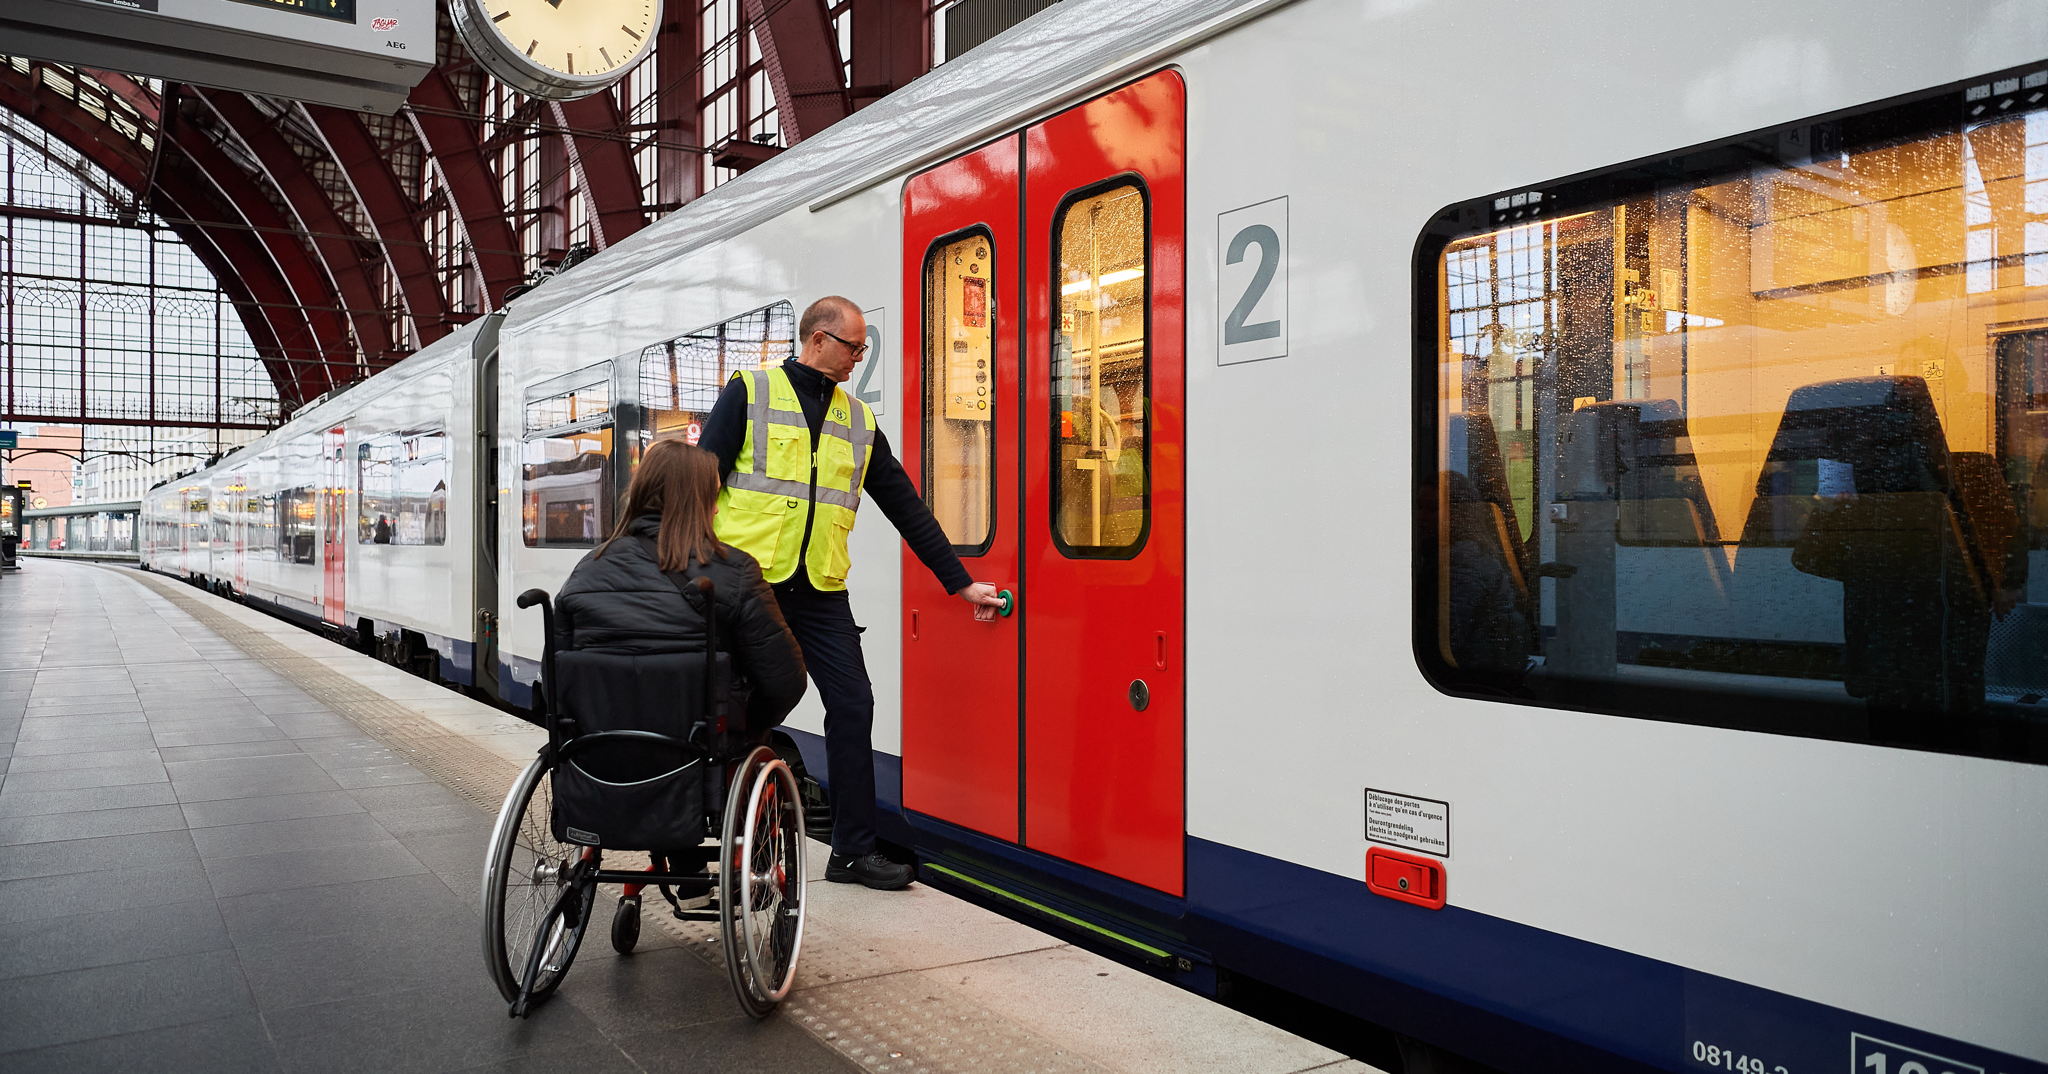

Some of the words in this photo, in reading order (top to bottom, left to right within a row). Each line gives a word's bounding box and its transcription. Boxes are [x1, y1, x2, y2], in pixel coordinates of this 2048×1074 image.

[386, 40, 406, 49] AEG
[1224, 223, 1281, 346] 2
[856, 324, 881, 404] 2
[1369, 793, 1394, 804] Déblocage
[1373, 801, 1394, 810] n'utiliser
[1419, 810, 1442, 820] d'urgence
[1369, 817, 1414, 832] Deurontgrendeling
[1370, 825, 1386, 834] slechts
[1394, 831, 1418, 841] noodgeval
[1420, 835, 1444, 846] gebruiken
